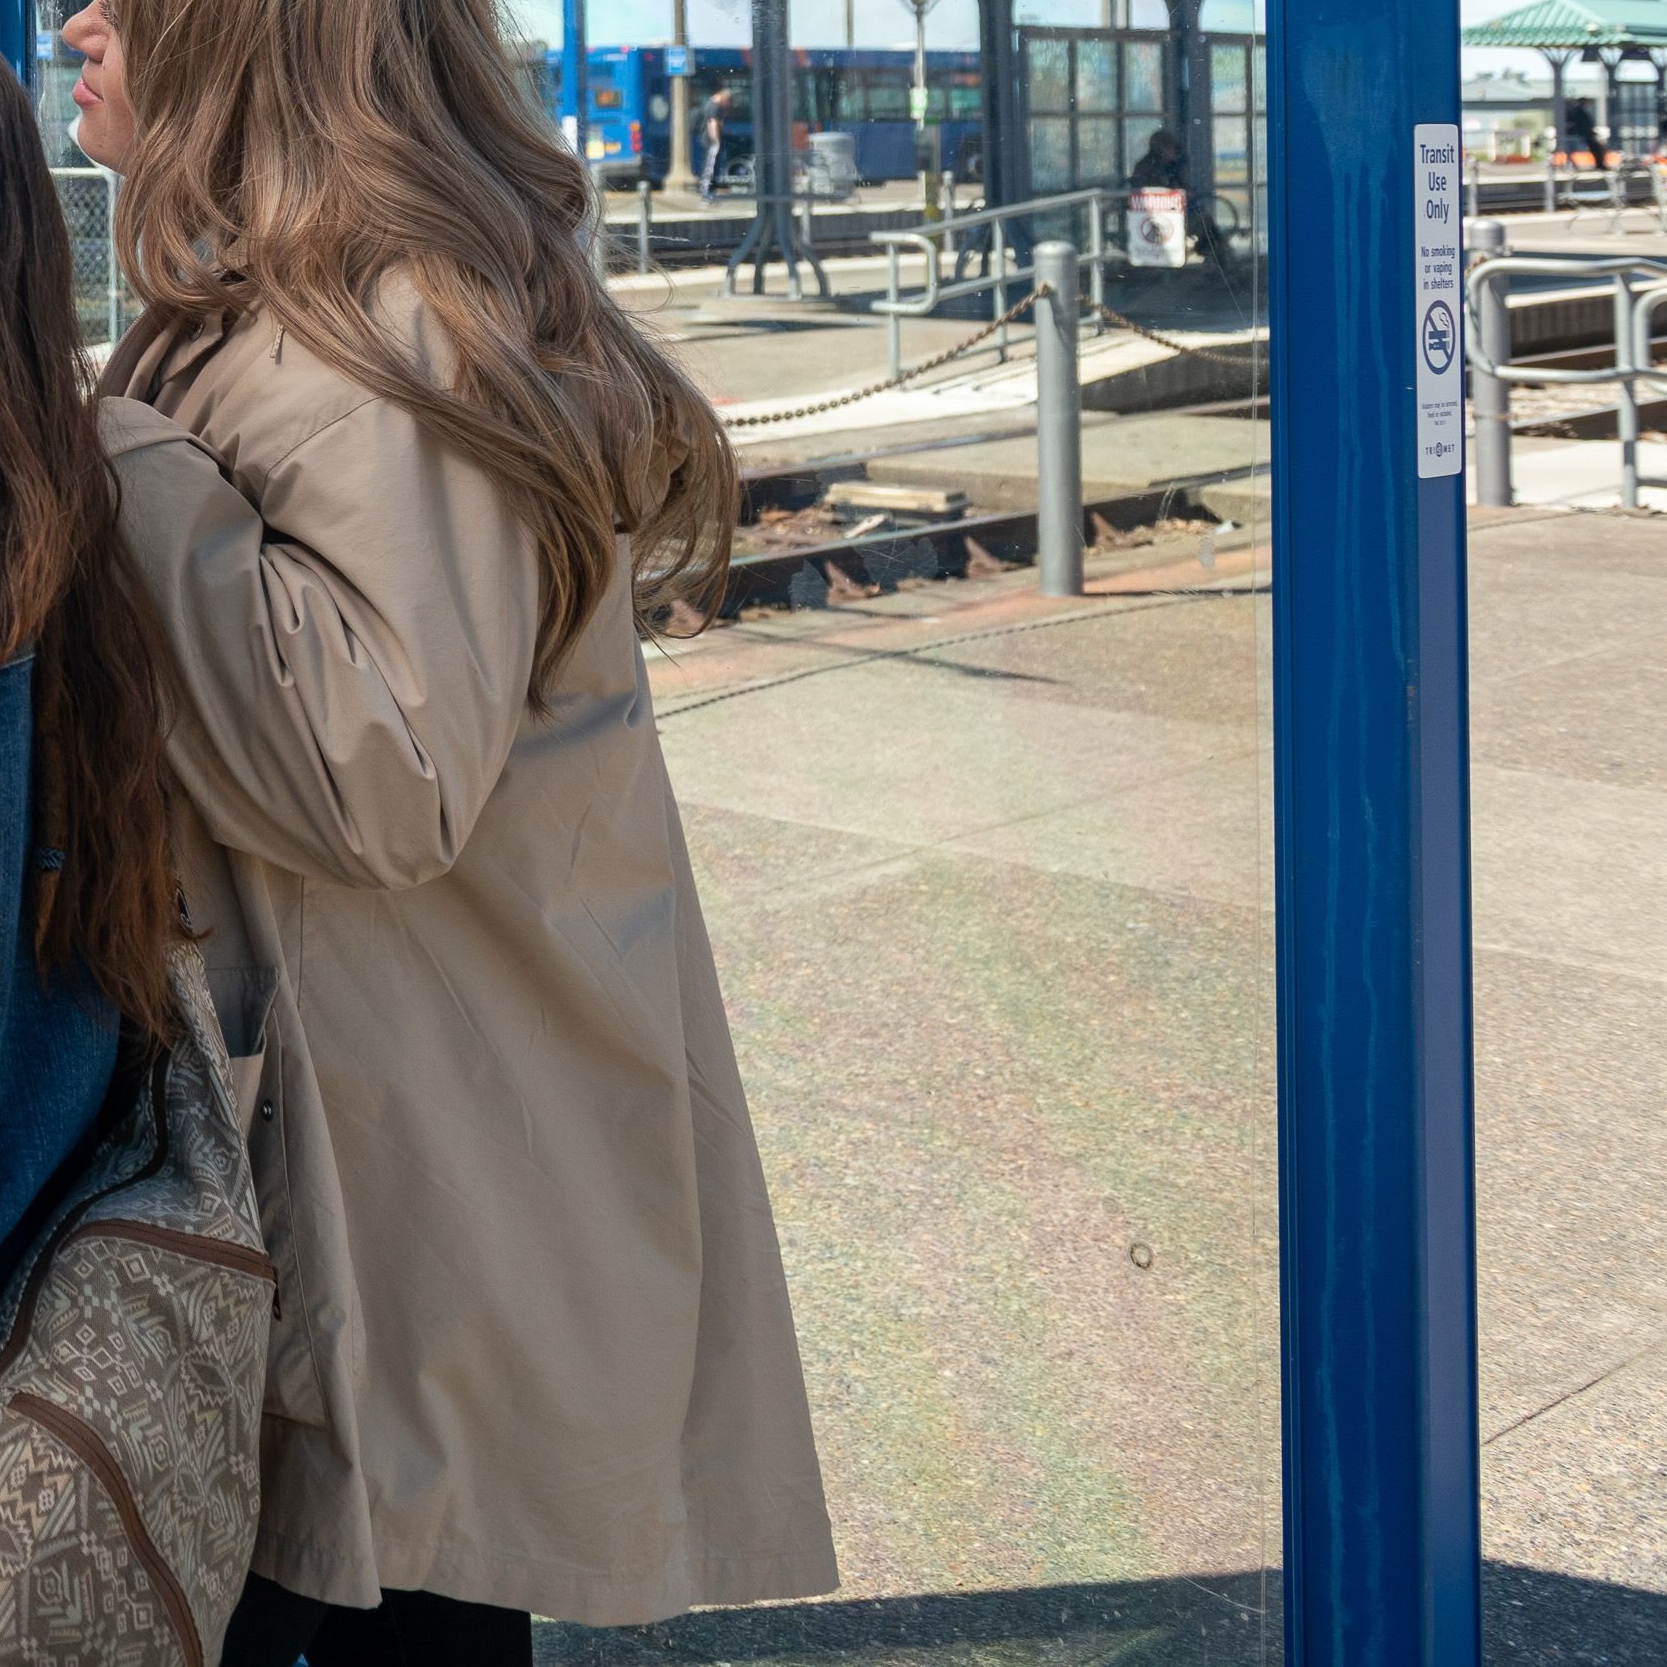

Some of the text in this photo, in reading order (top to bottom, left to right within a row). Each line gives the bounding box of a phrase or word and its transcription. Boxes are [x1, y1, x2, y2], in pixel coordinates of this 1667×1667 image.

[1420, 143, 1455, 164] Transit
[1429, 172, 1447, 191] Use
[1426, 199, 1449, 224] Only
[1421, 245, 1455, 259] No smoking
[1425, 264, 1452, 276] or vaping
[1424, 278, 1454, 290] in shelters
